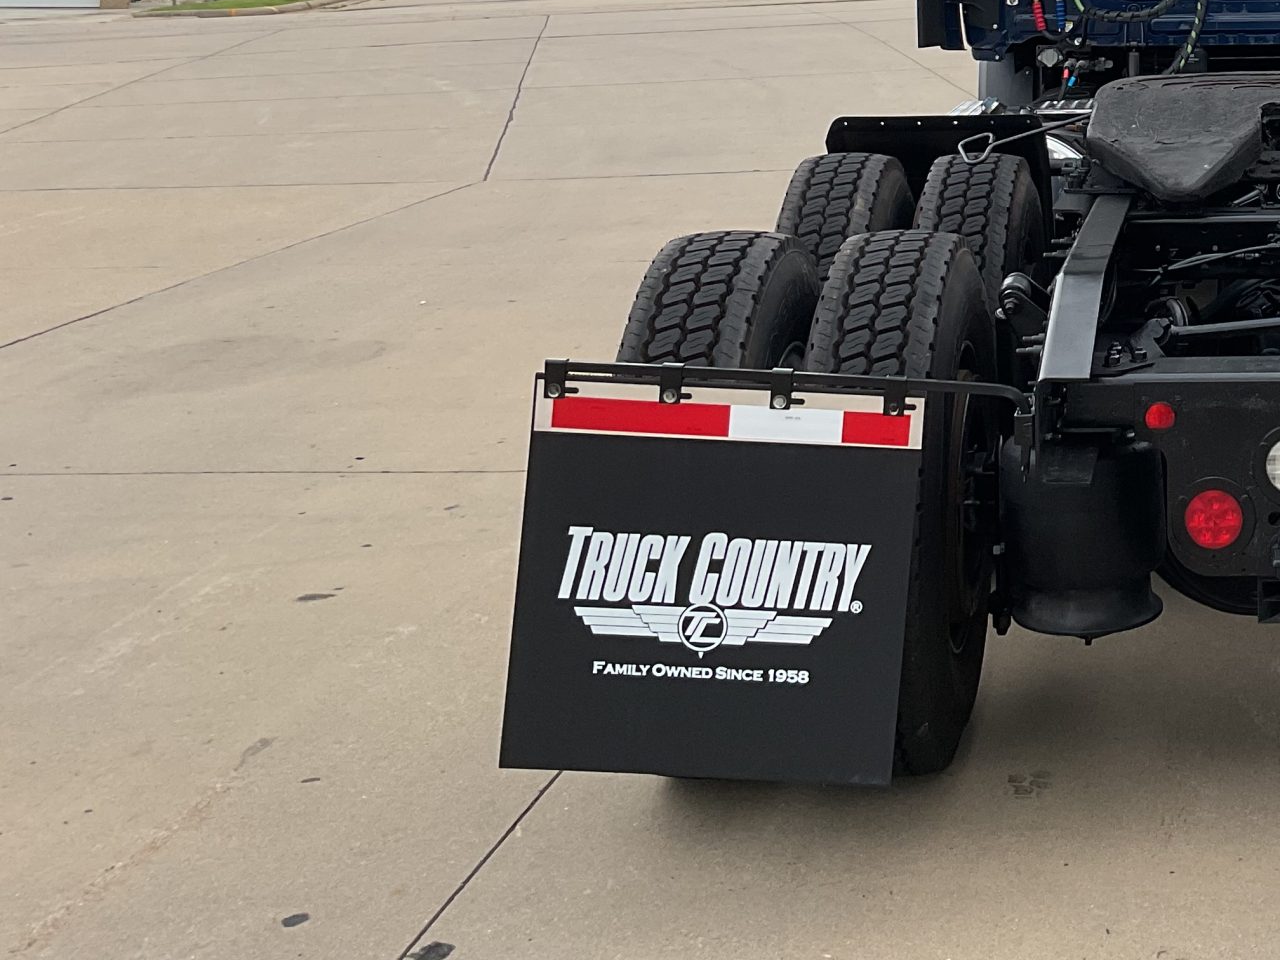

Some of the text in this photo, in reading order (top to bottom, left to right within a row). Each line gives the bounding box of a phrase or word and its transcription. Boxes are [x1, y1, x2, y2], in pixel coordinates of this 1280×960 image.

[558, 526, 692, 604] TRUCK
[592, 660, 810, 684] FAMILY OWNED SINCE 1958
